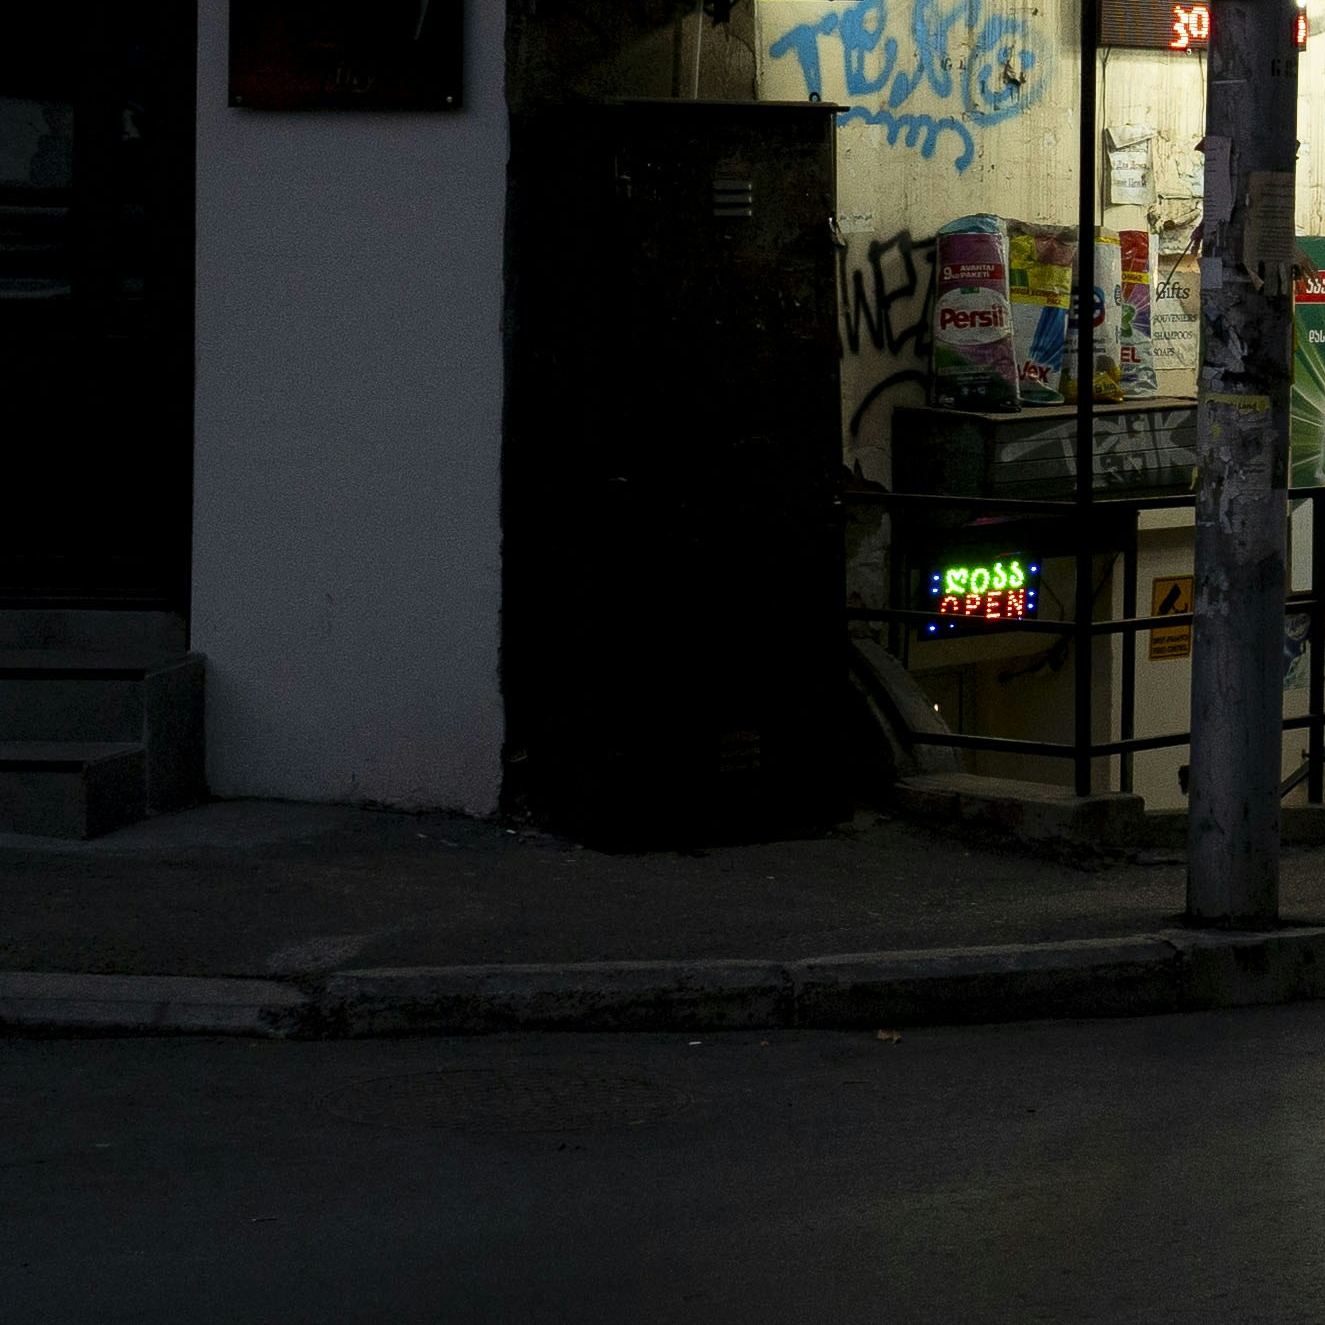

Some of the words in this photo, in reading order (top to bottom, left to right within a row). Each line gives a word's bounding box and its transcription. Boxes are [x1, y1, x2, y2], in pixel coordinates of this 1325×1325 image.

[1156, 281, 1191, 300] Gifts
[940, 303, 1004, 331] Persil
[940, 587, 1025, 619] OPEN
